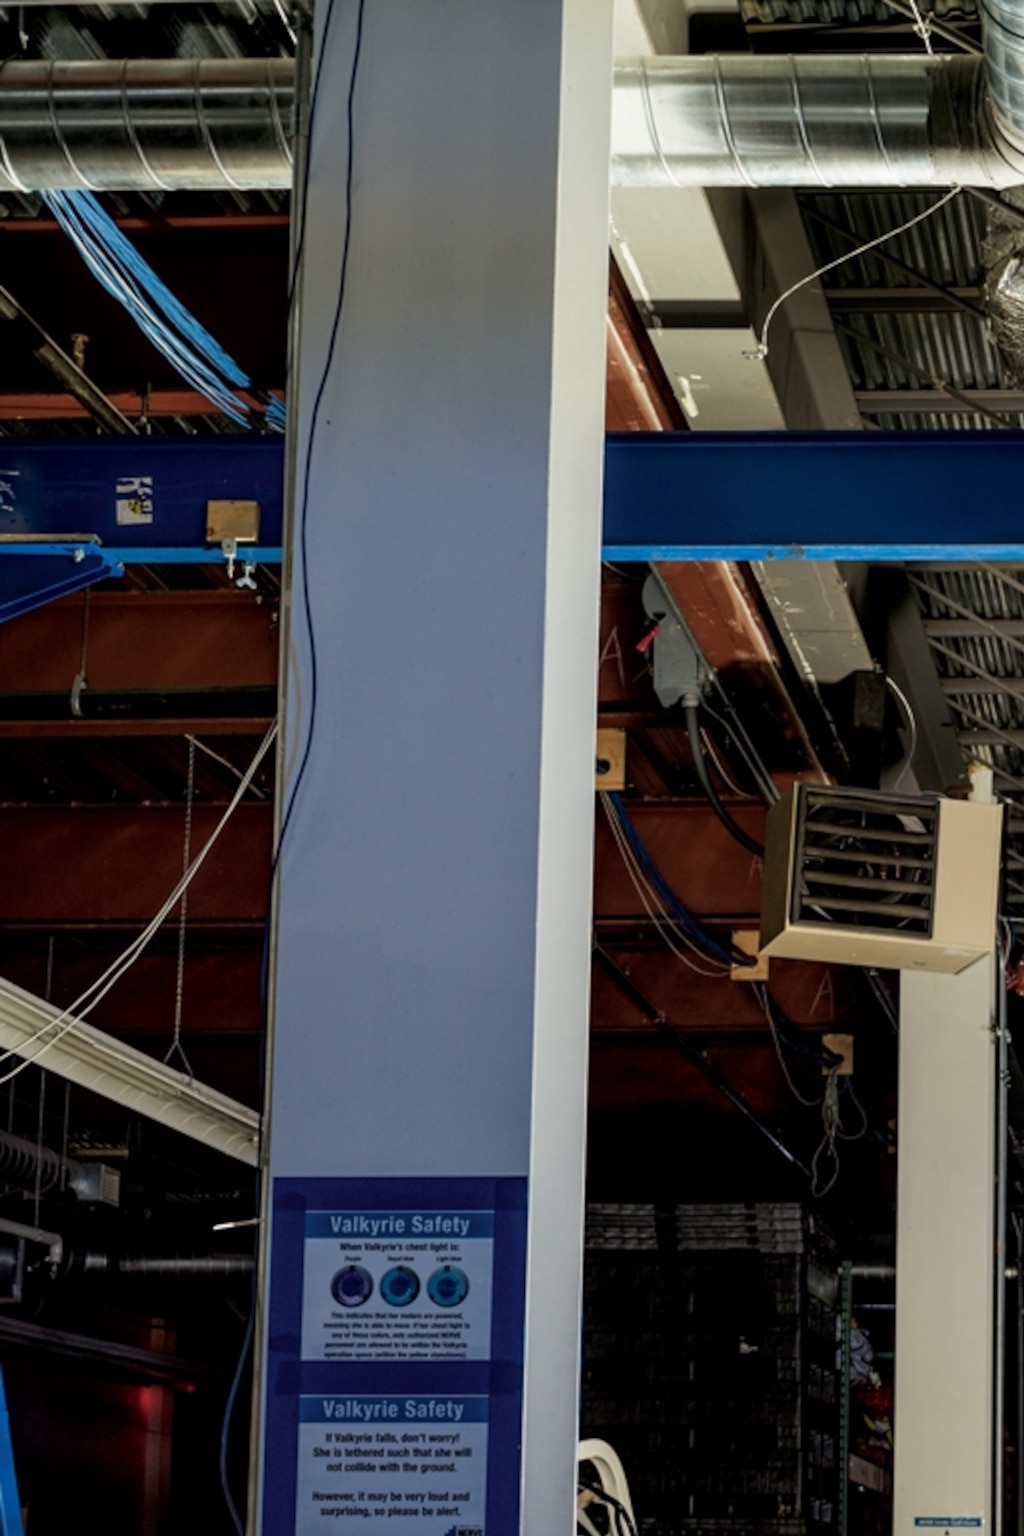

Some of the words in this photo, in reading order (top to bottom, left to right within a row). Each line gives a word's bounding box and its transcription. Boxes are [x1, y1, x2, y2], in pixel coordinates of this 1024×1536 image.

[330, 1215, 406, 1237] Valkyrie
[411, 1215, 471, 1237] Safety
[339, 1242, 362, 1251] When
[364, 1242, 403, 1253] Valkyrie's
[404, 1242, 428, 1251] chest
[430, 1242, 448, 1253] light
[450, 1242, 460, 1251] is:
[322, 1400, 399, 1422] Valkyrie
[404, 1400, 464, 1422] Safety
[325, 1432, 333, 1443] If
[334, 1432, 373, 1445] Valkyrie
[375, 1432, 399, 1445] falls,
[401, 1432, 427, 1443] don't
[428, 1432, 461, 1445] worry!
[312, 1447, 331, 1457] She
[334, 1447, 342, 1457] is
[344, 1447, 385, 1457] tethered
[387, 1447, 410, 1457] such
[412, 1447, 432, 1457] that
[434, 1447, 452, 1457] she
[454, 1447, 472, 1457] will
[326, 1462, 343, 1473] not
[344, 1462, 376, 1473] collide
[379, 1462, 401, 1473] with
[402, 1462, 418, 1473] the
[420, 1462, 457, 1475] ground.
[312, 1491, 356, 1503] However,
[358, 1491, 365, 1501] it
[367, 1493, 388, 1503] may
[390, 1491, 402, 1501] be
[404, 1493, 426, 1503] very
[428, 1491, 449, 1501] loud
[451, 1491, 470, 1501] and
[320, 1506, 372, 1518] surprising,
[373, 1508, 386, 1516] so
[388, 1506, 419, 1518] please
[421, 1506, 434, 1516] be
[436, 1506, 461, 1516] alert.
